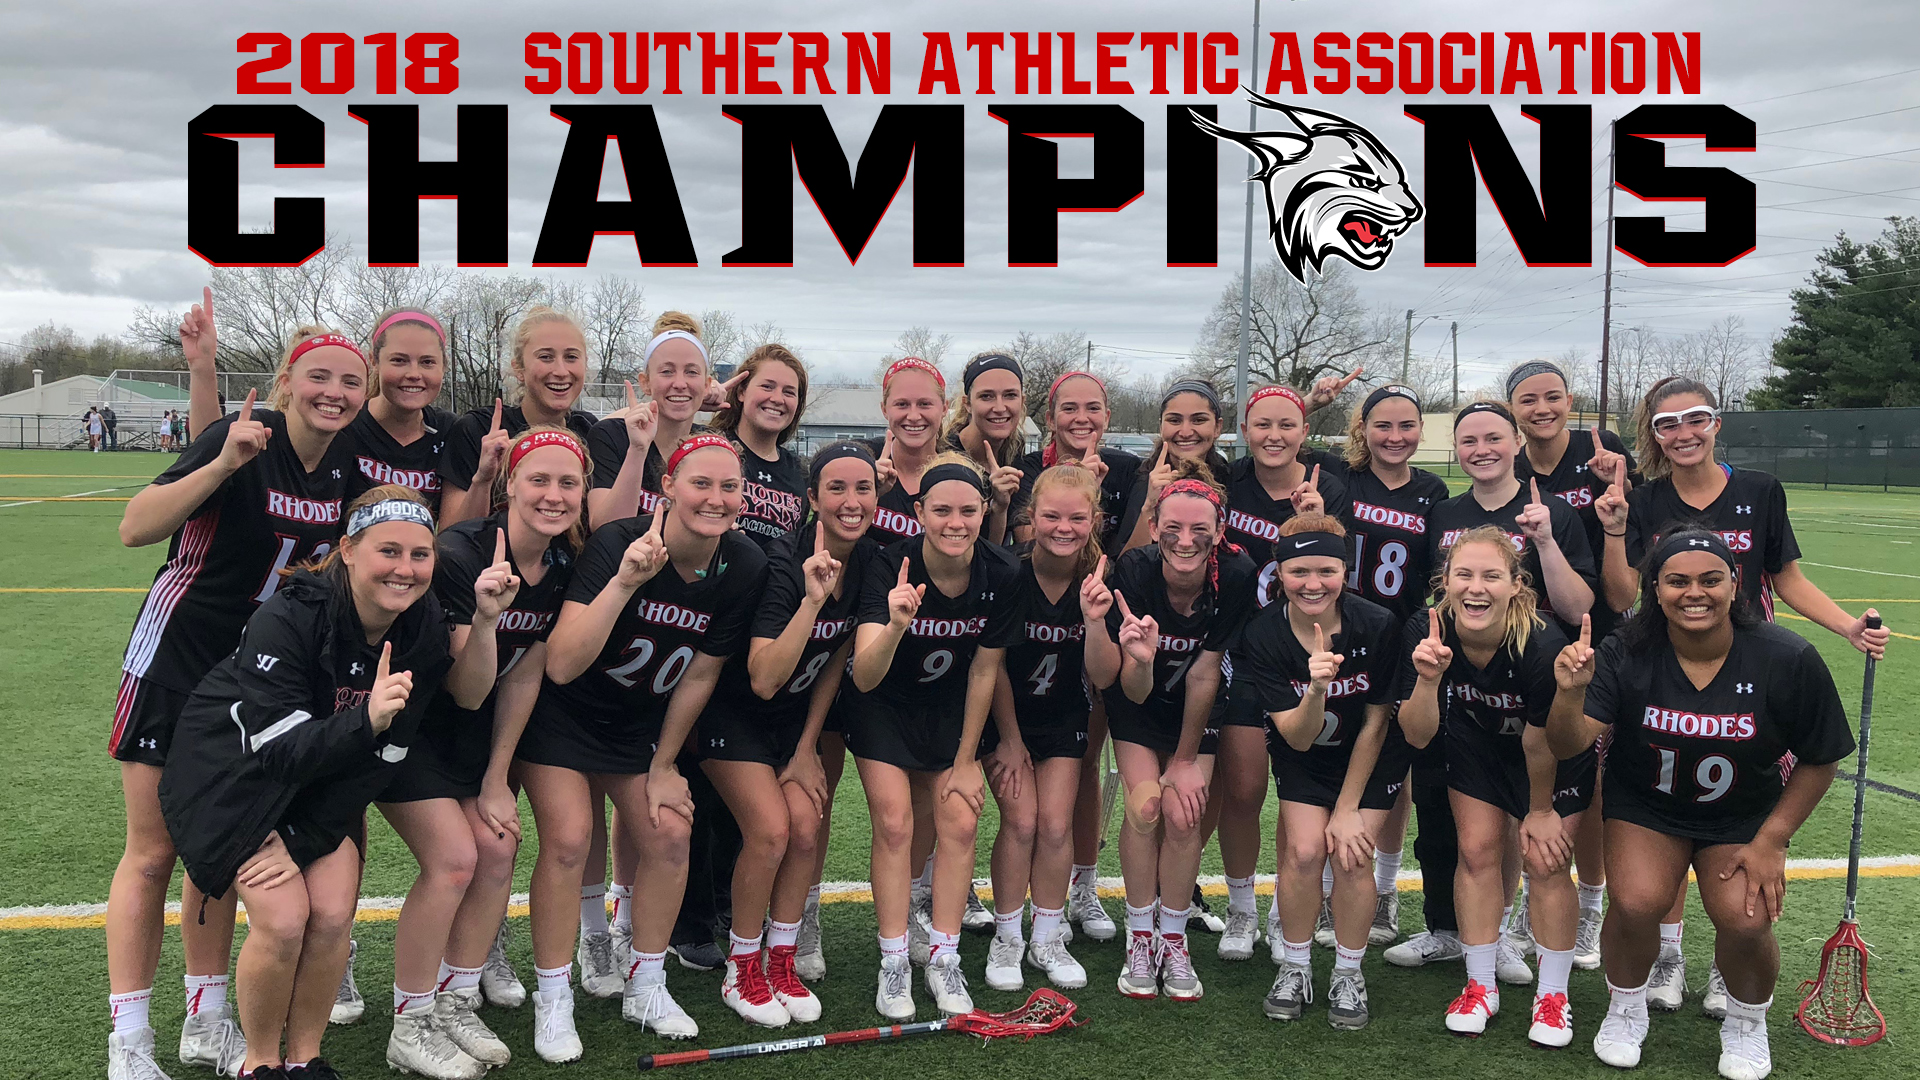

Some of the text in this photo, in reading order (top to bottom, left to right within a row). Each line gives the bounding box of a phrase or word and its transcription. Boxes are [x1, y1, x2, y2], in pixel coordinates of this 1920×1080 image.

[267, 489, 342, 524] RHODES
[371, 501, 428, 522] RHODES
[736, 492, 800, 531] YNX
[740, 480, 801, 513] HODES
[1228, 508, 1280, 544] RHOD
[1353, 501, 1427, 534] HODES
[637, 598, 711, 633] RHODE
[605, 637, 696, 695] 20
[788, 650, 830, 694] 8
[917, 649, 955, 683] 9
[1027, 653, 1058, 696] 4
[1164, 655, 1194, 693] 7
[1641, 705, 1758, 742] RHODES
[1652, 746, 1737, 804] 19
[758, 1039, 808, 1054] UNDER
